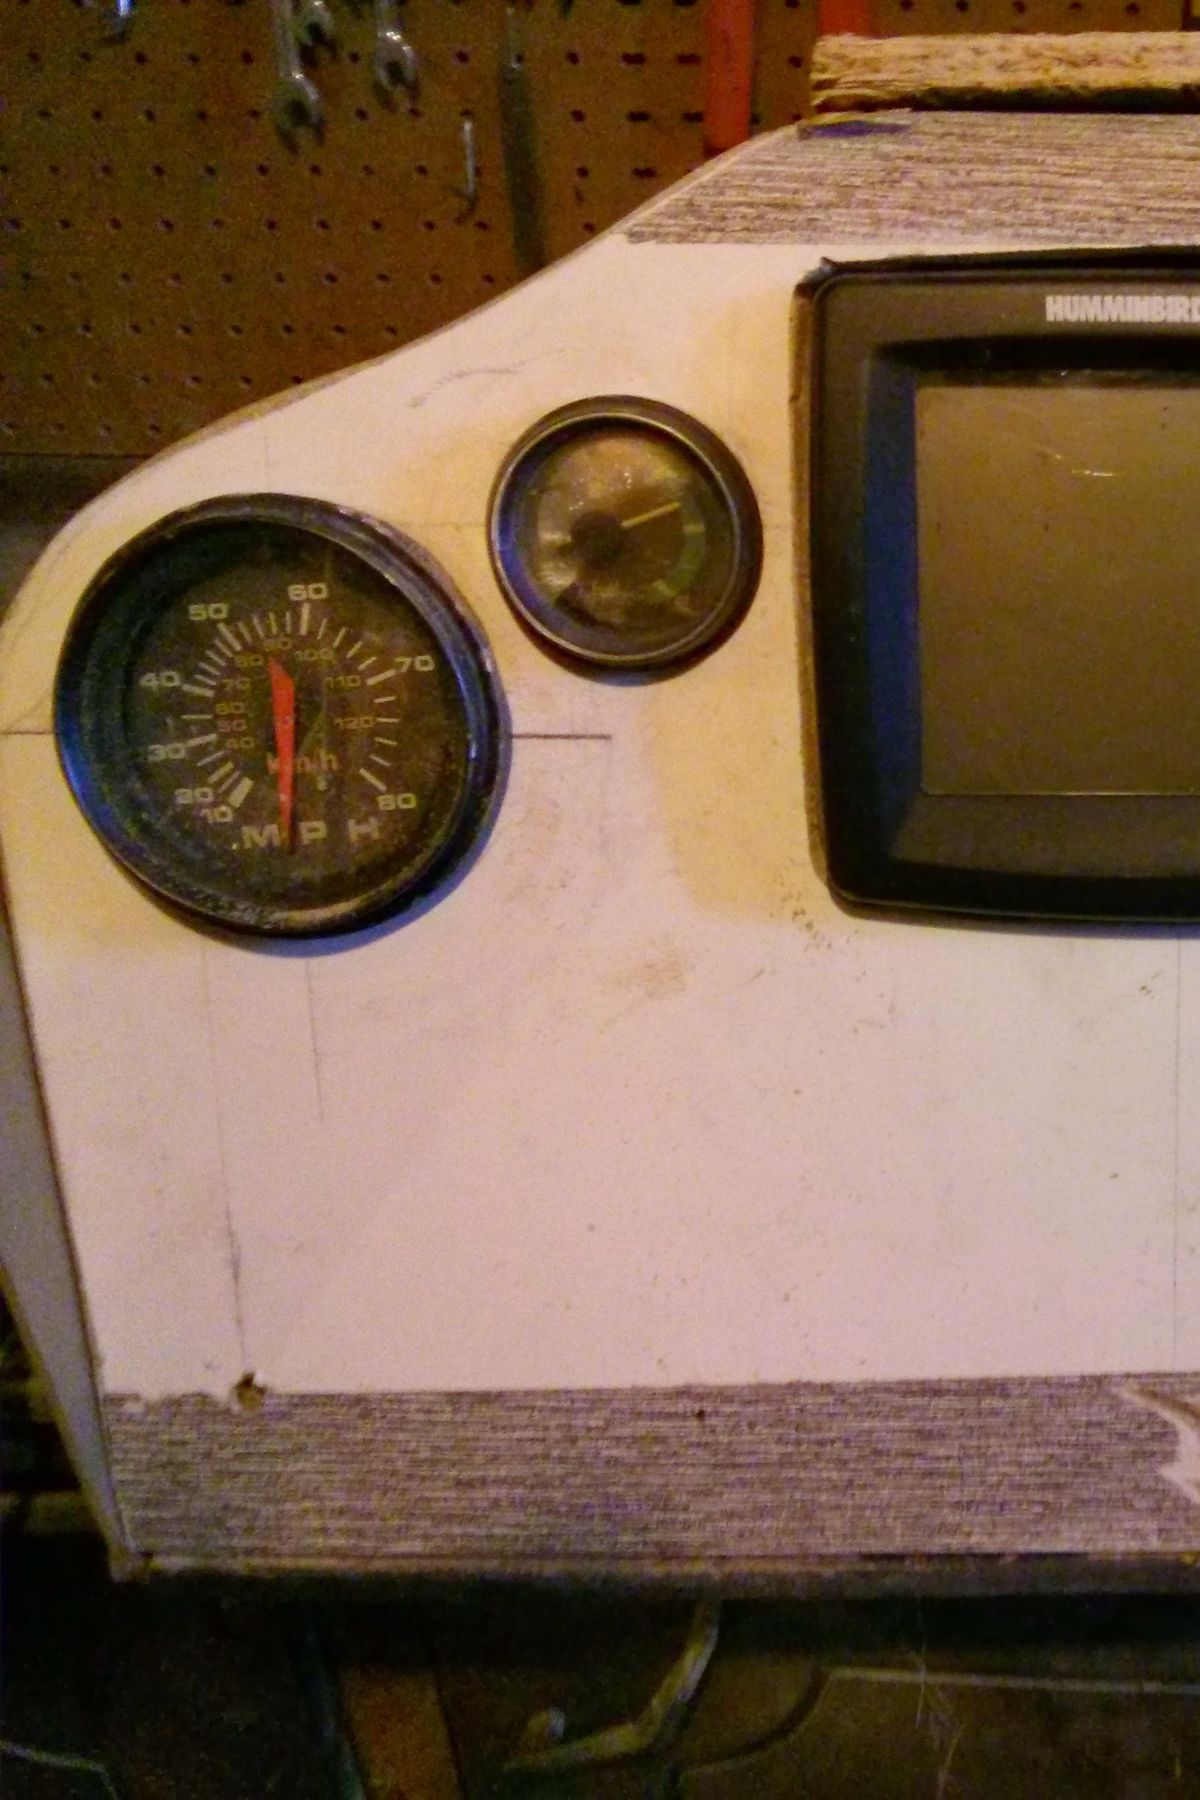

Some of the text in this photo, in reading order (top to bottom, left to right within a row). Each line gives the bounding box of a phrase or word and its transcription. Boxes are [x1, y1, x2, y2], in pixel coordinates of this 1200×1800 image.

[288, 582, 329, 601] 60
[188, 602, 230, 622] 50
[395, 655, 436, 674] 70
[139, 671, 182, 690] 40
[148, 743, 188, 763] 30
[201, 805, 234, 824] 10
